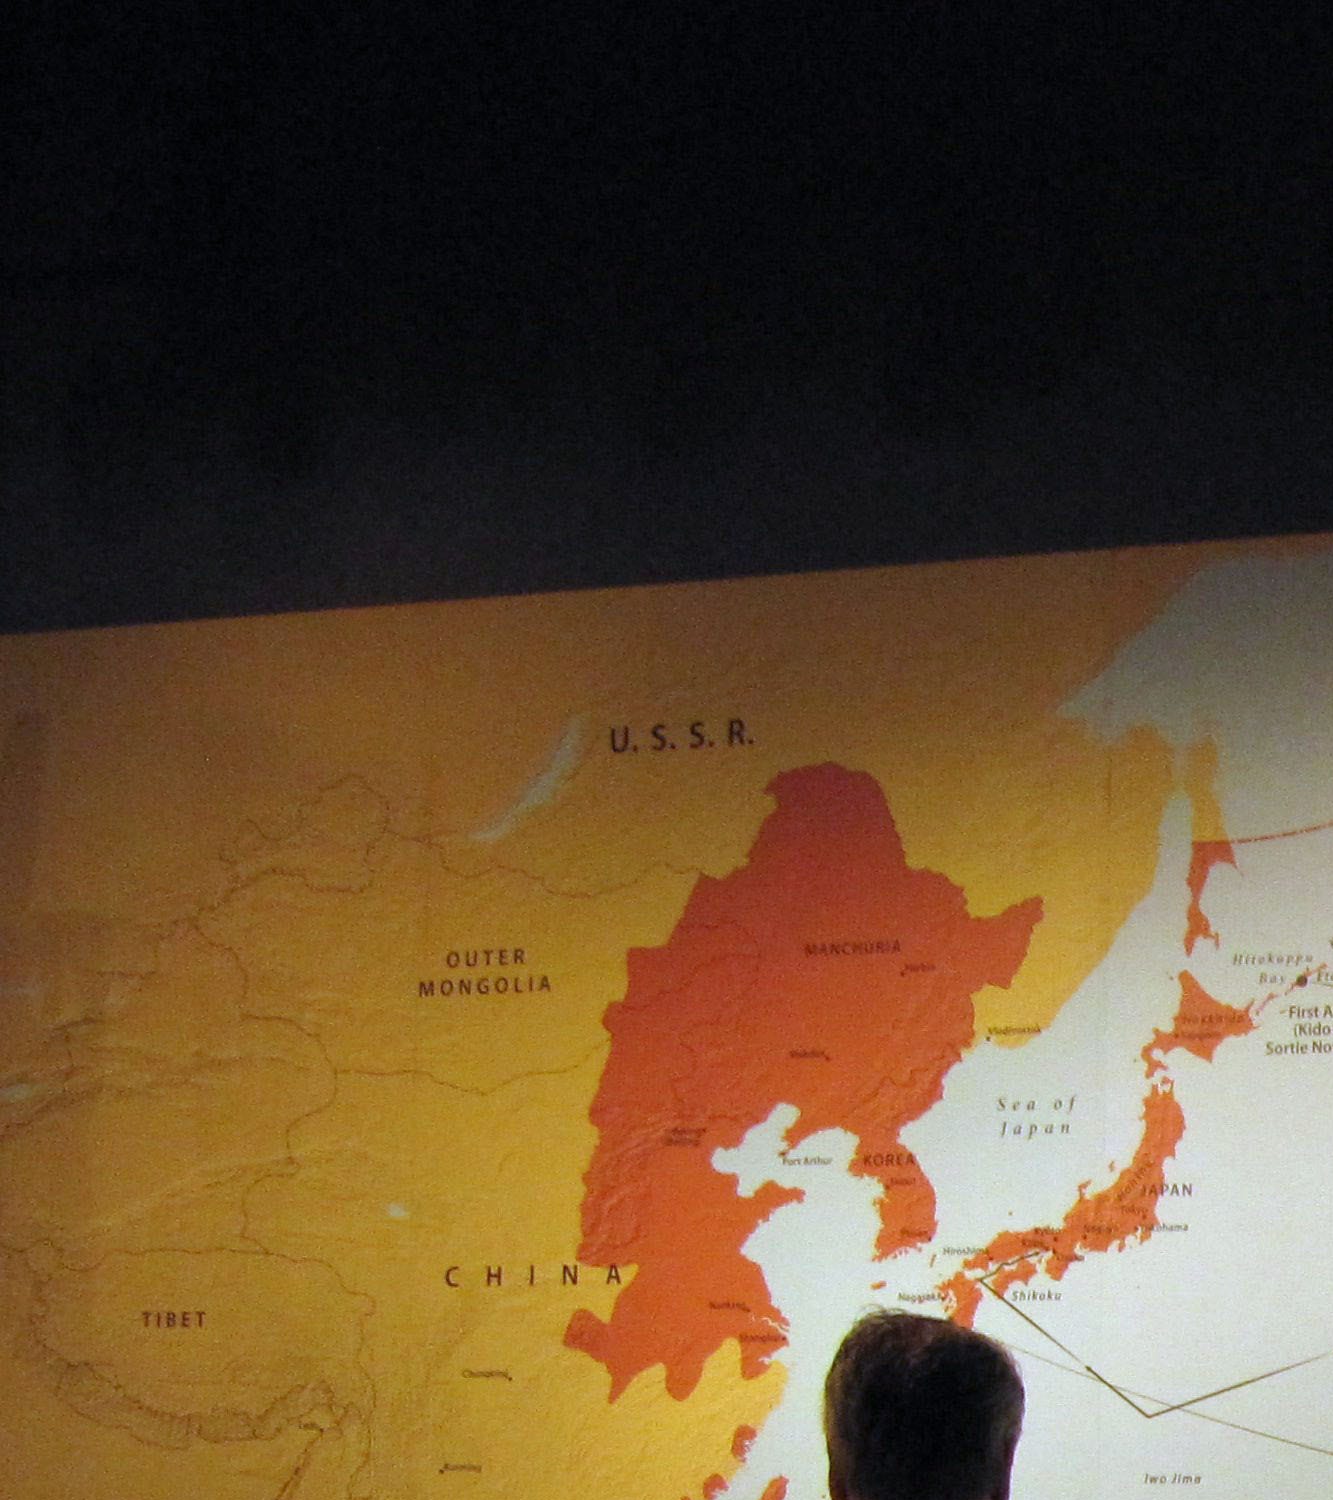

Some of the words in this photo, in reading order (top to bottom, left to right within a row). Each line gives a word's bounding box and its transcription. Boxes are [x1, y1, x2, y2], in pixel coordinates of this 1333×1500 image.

[445, 947, 525, 970] OUTER
[418, 974, 552, 998] MONGOLIA
[1288, 1005, 1320, 1019] First
[1293, 1021, 1332, 1038] (Kido
[1265, 1041, 1309, 1056] Sortie
[996, 1097, 1036, 1112] Sea
[1052, 1094, 1077, 1114] of
[1000, 1120, 1071, 1141] Japan
[444, 1262, 622, 1289] CHINA
[141, 1310, 207, 1329] TIBET
